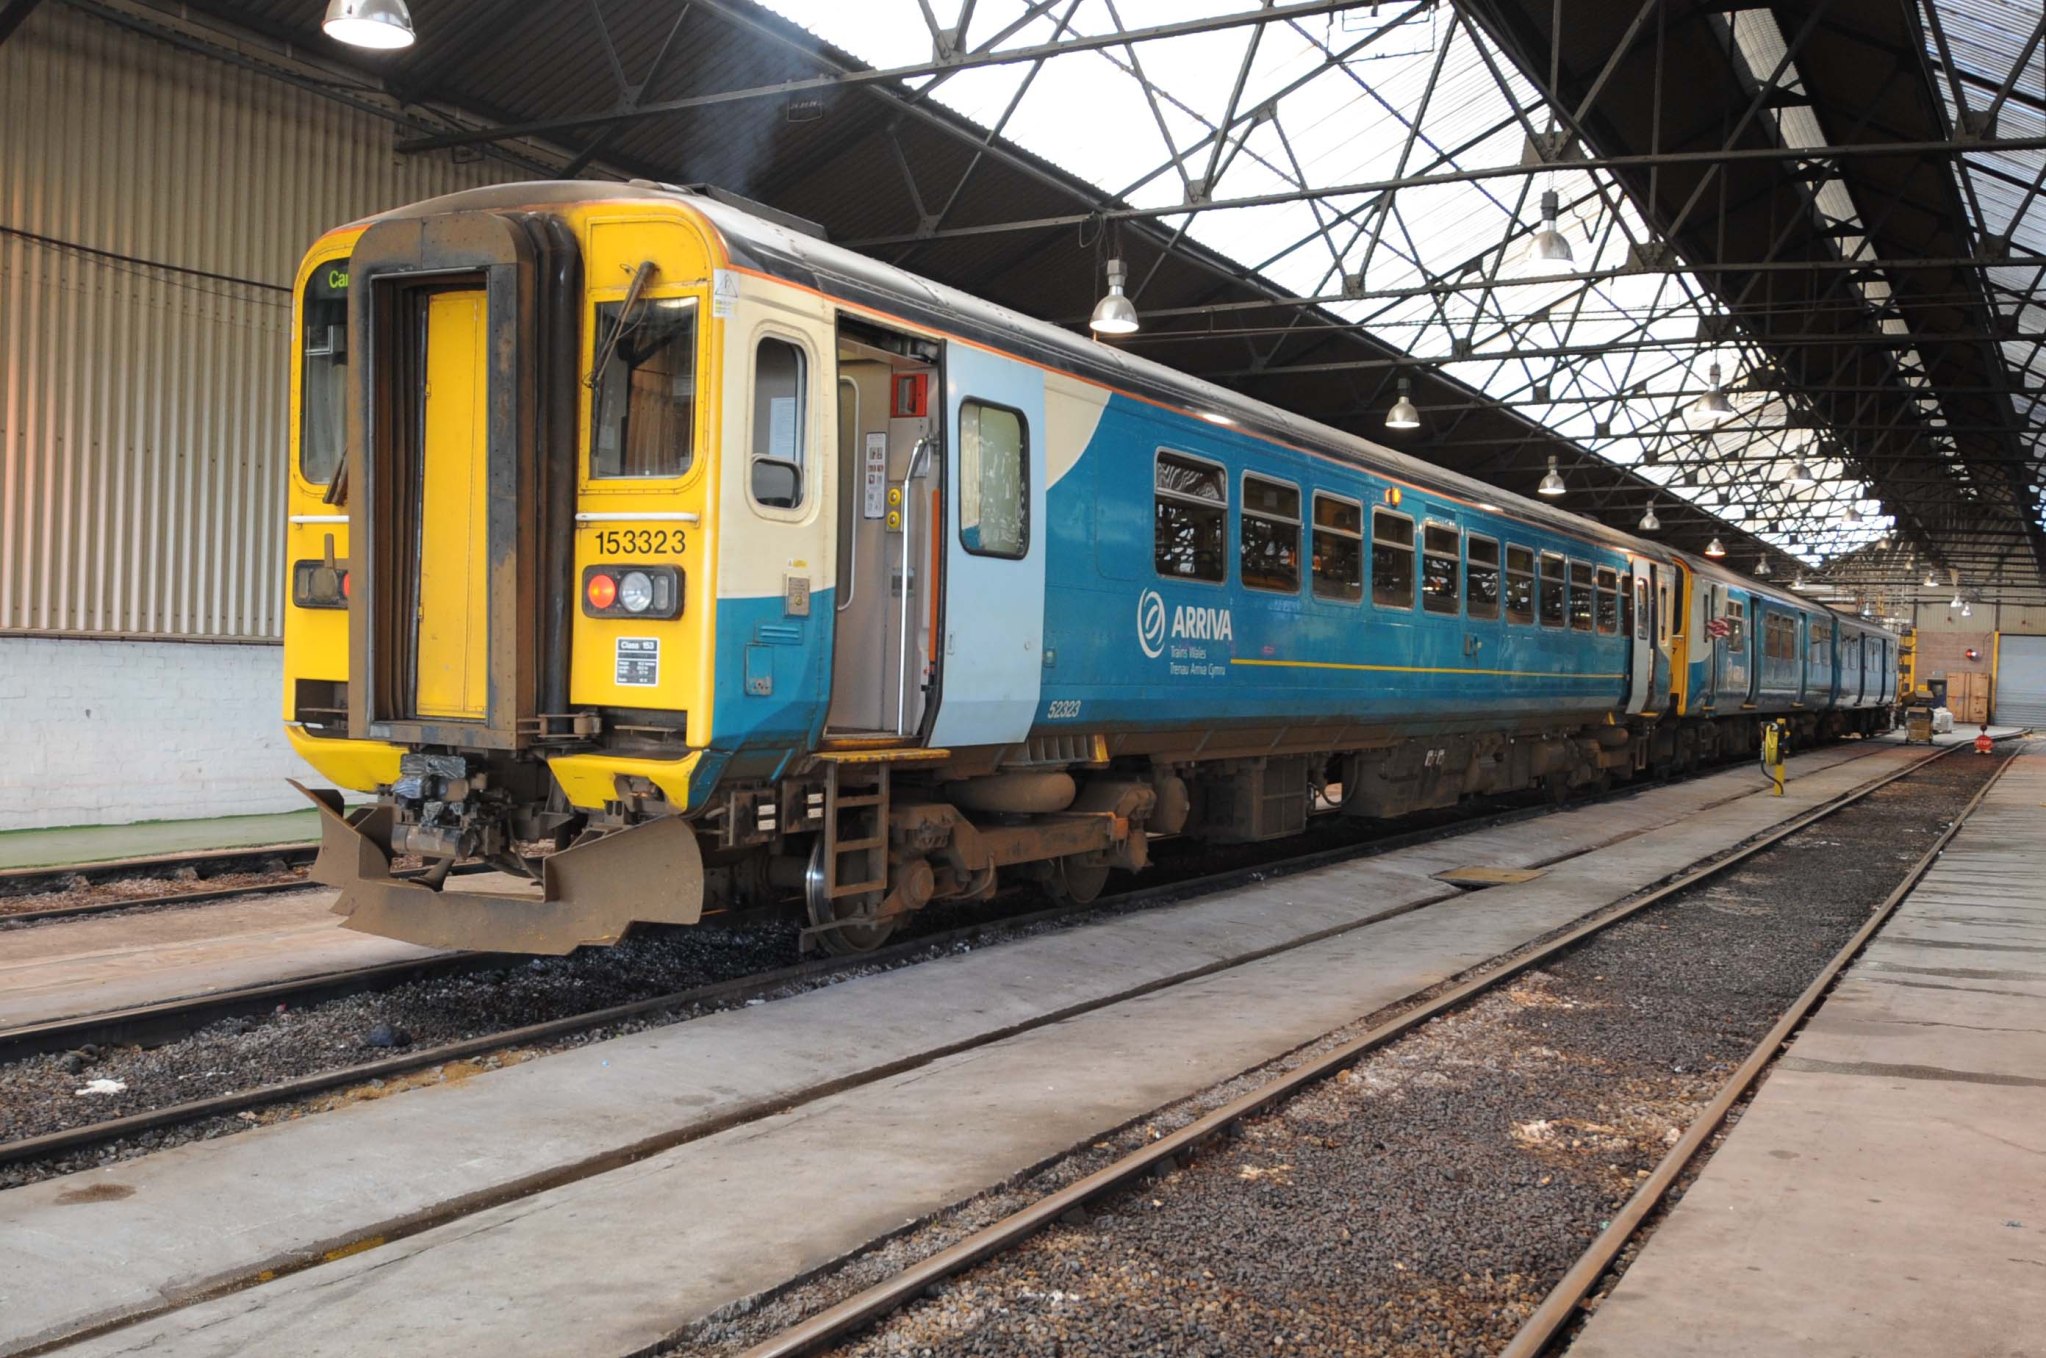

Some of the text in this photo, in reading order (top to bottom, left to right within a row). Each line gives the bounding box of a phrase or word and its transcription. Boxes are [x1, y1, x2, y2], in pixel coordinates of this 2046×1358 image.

[595, 530, 686, 554] 153323
[1171, 605, 1232, 641] ARRIVA
[620, 641, 654, 650] Class 153
[1170, 645, 1206, 659] Trains Wales
[1169, 662, 1225, 679] Trenau Arriva Cymru
[1047, 700, 1081, 719] 52323
